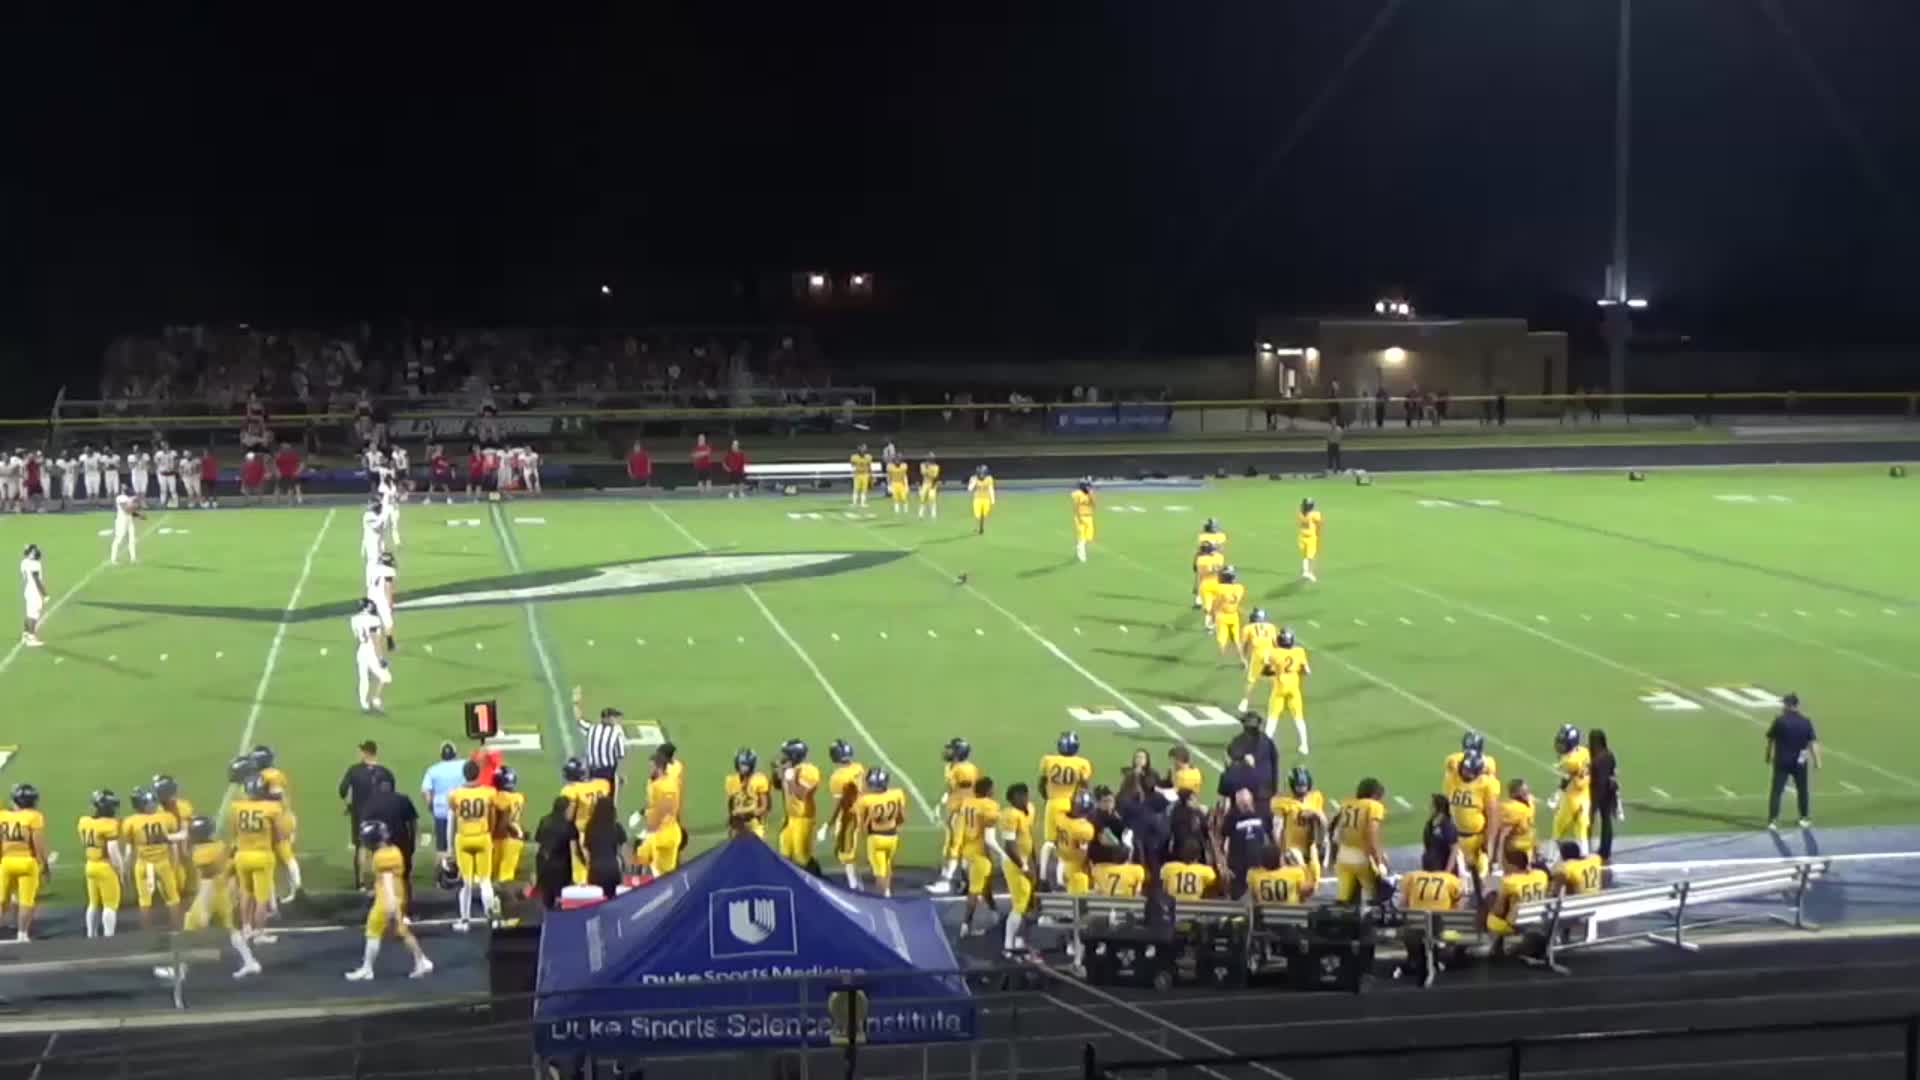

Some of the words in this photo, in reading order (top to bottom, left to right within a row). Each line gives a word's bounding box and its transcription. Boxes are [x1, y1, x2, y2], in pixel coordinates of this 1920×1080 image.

[1284, 655, 1294, 673] 2
[474, 704, 488, 732] 1
[1050, 764, 1074, 784] 20
[460, 798, 484, 818] 80
[239, 810, 264, 833] 85
[1107, 873, 1120, 891] 7
[1175, 872, 1197, 894] 18
[1415, 878, 1444, 901] 77
[551, 1018, 622, 1040] Duke
[631, 1015, 718, 1041] Sports
[858, 1009, 961, 1034] nstitute
